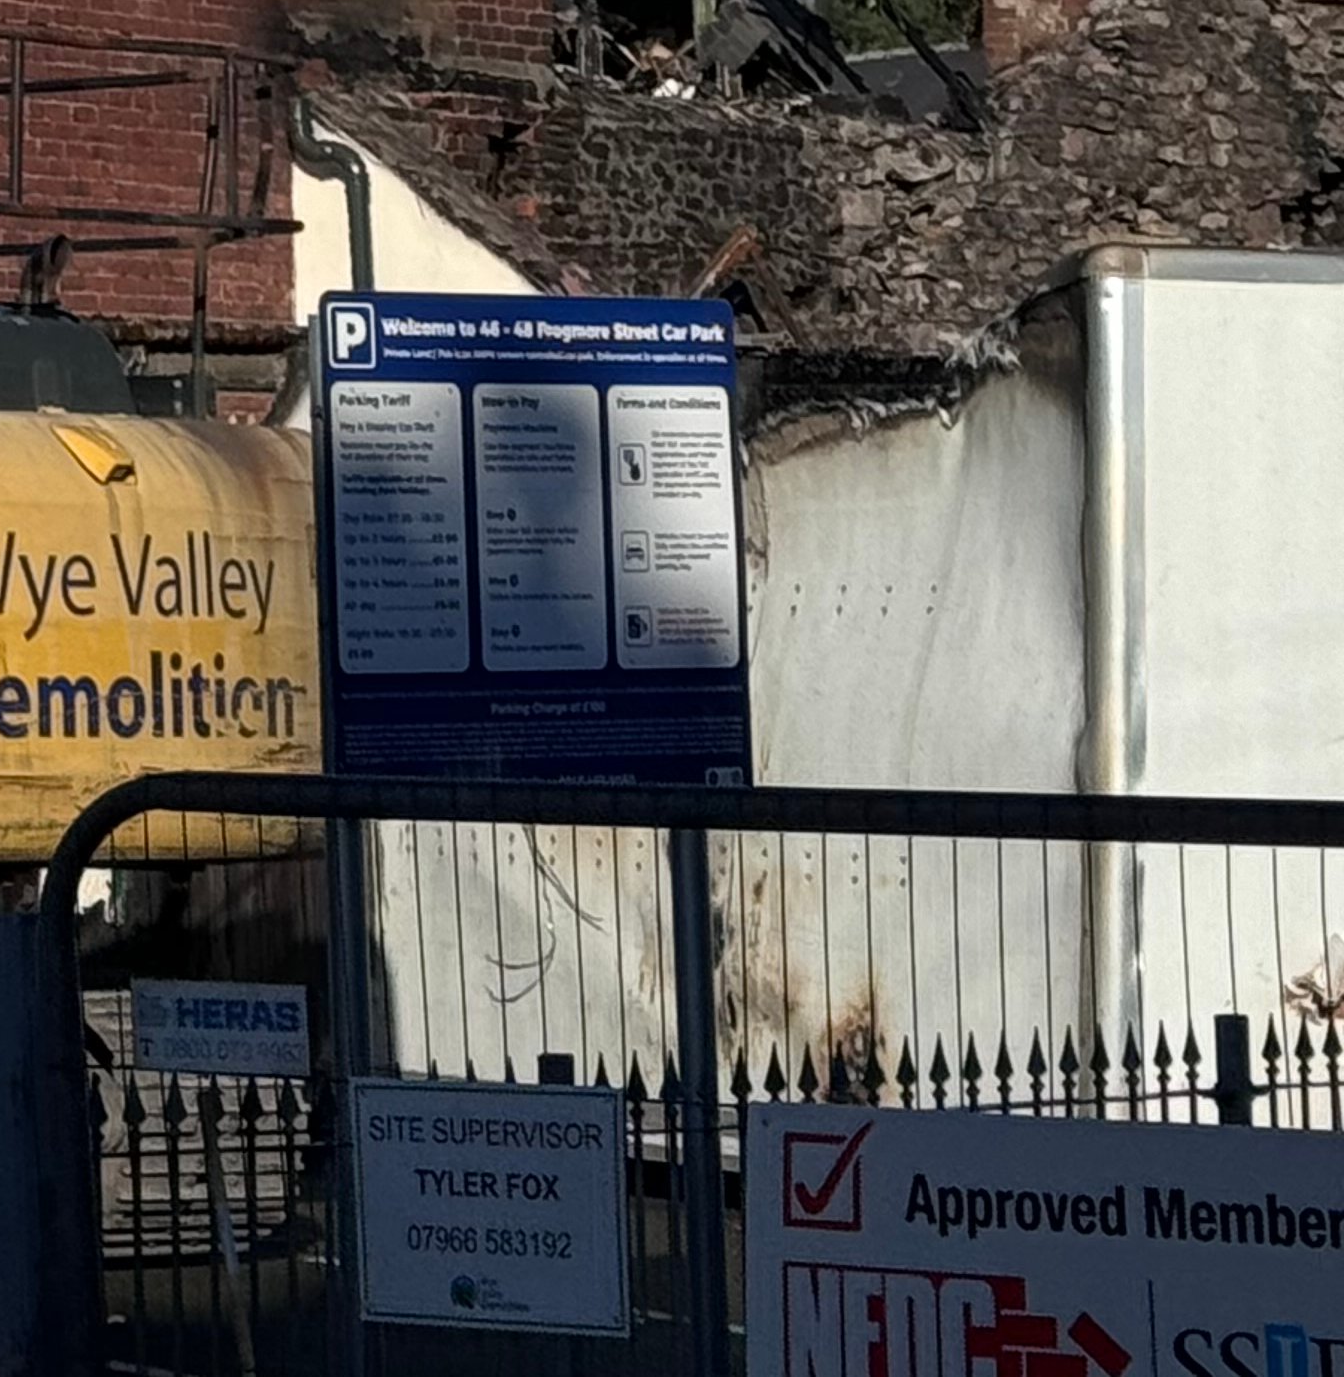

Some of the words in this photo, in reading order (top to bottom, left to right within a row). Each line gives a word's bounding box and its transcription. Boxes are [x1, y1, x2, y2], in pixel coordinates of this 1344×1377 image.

[381, 318, 455, 336] Welcome
[460, 320, 476, 336] to
[614, 323, 658, 339] Street
[662, 324, 688, 340] Car
[691, 324, 725, 341] Park
[669, 398, 721, 410] Conditions
[111, 529, 275, 635] Valley
[175, 997, 300, 1032] HERAS
[369, 1114, 425, 1143] SITE
[432, 1117, 603, 1150] SUPERVISOR
[414, 1169, 498, 1198] TYLER
[507, 1174, 560, 1200] FOX
[905, 1173, 1127, 1239] Approved
[1144, 1186, 1344, 1249] Member
[408, 1225, 478, 1254] 07966
[485, 1228, 572, 1258] 583192
